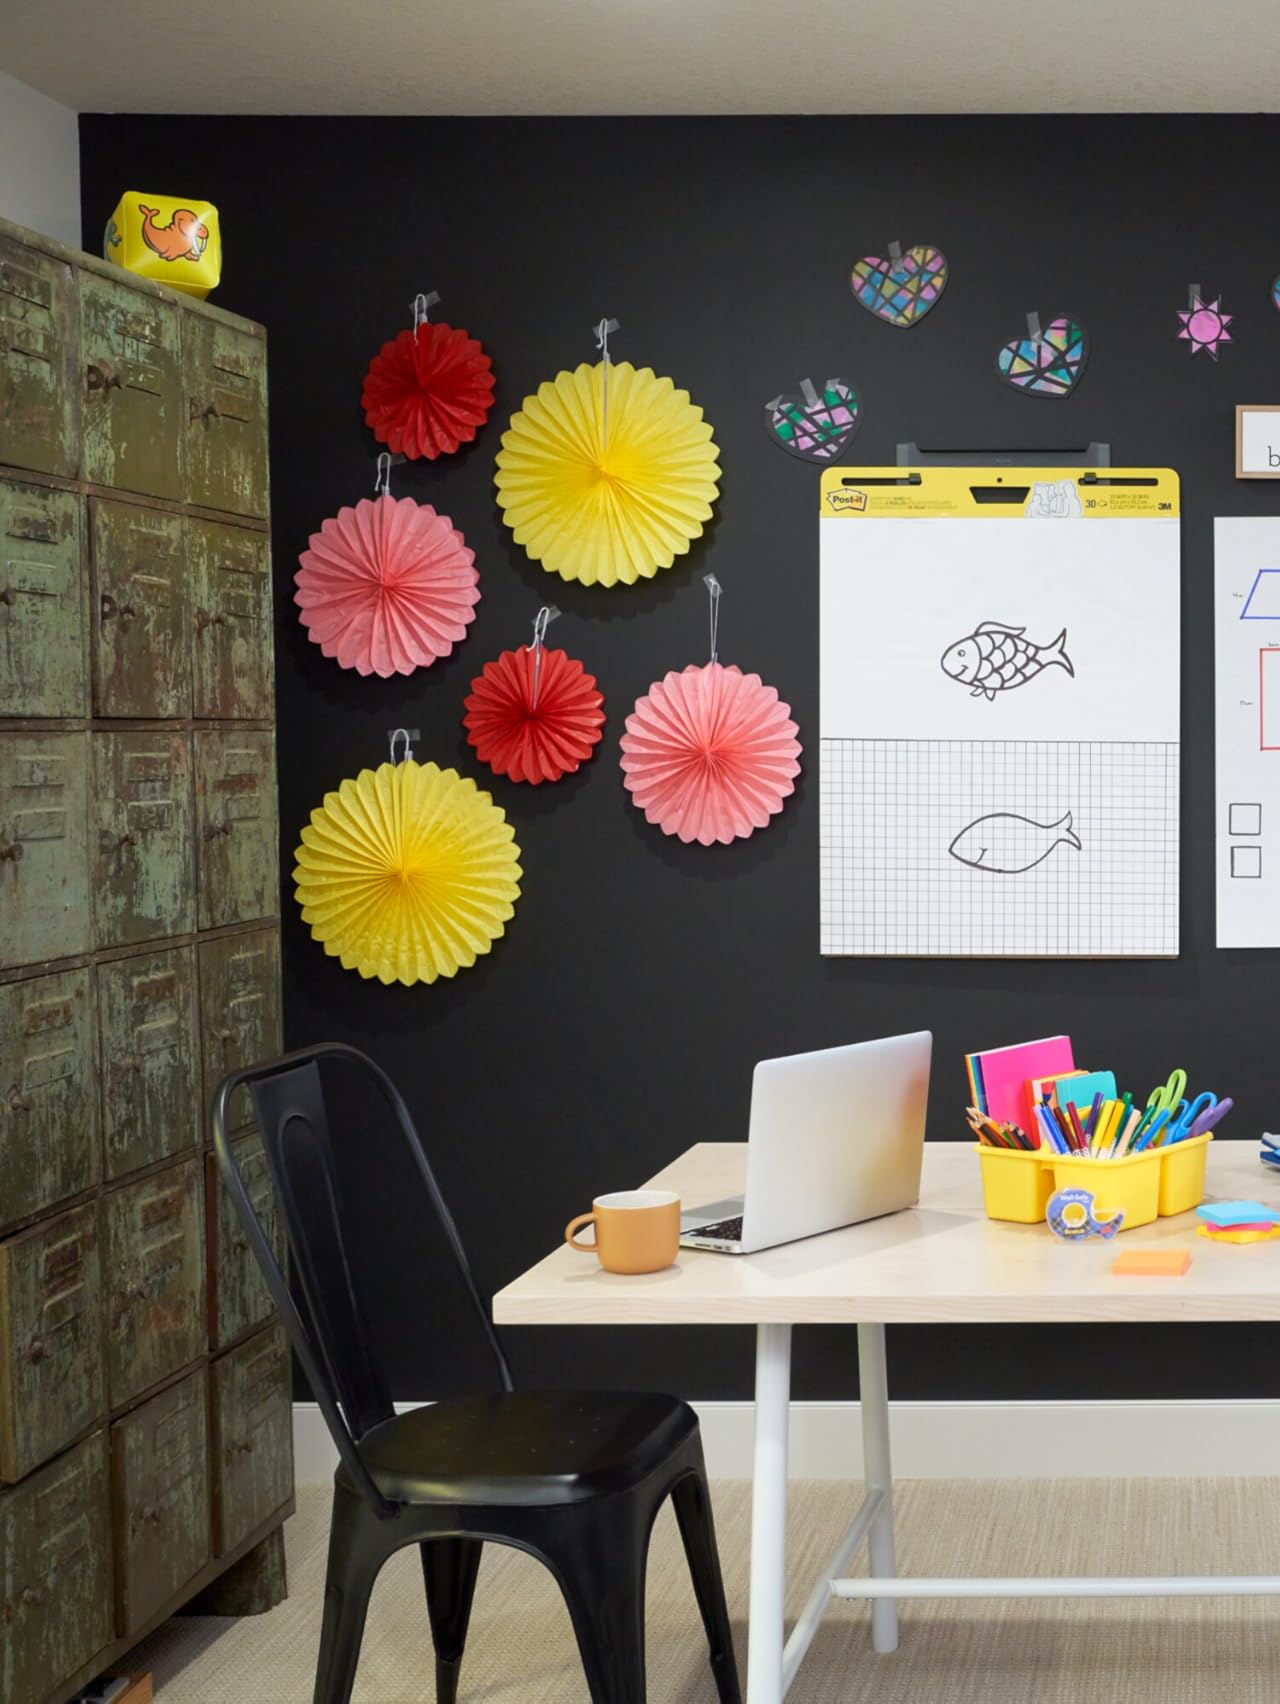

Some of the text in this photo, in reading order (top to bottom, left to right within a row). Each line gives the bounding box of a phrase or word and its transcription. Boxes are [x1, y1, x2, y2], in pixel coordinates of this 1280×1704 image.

[832, 494, 863, 504] Post-it
[1085, 499, 1097, 509] 30
[1158, 502, 1172, 511] 3M
